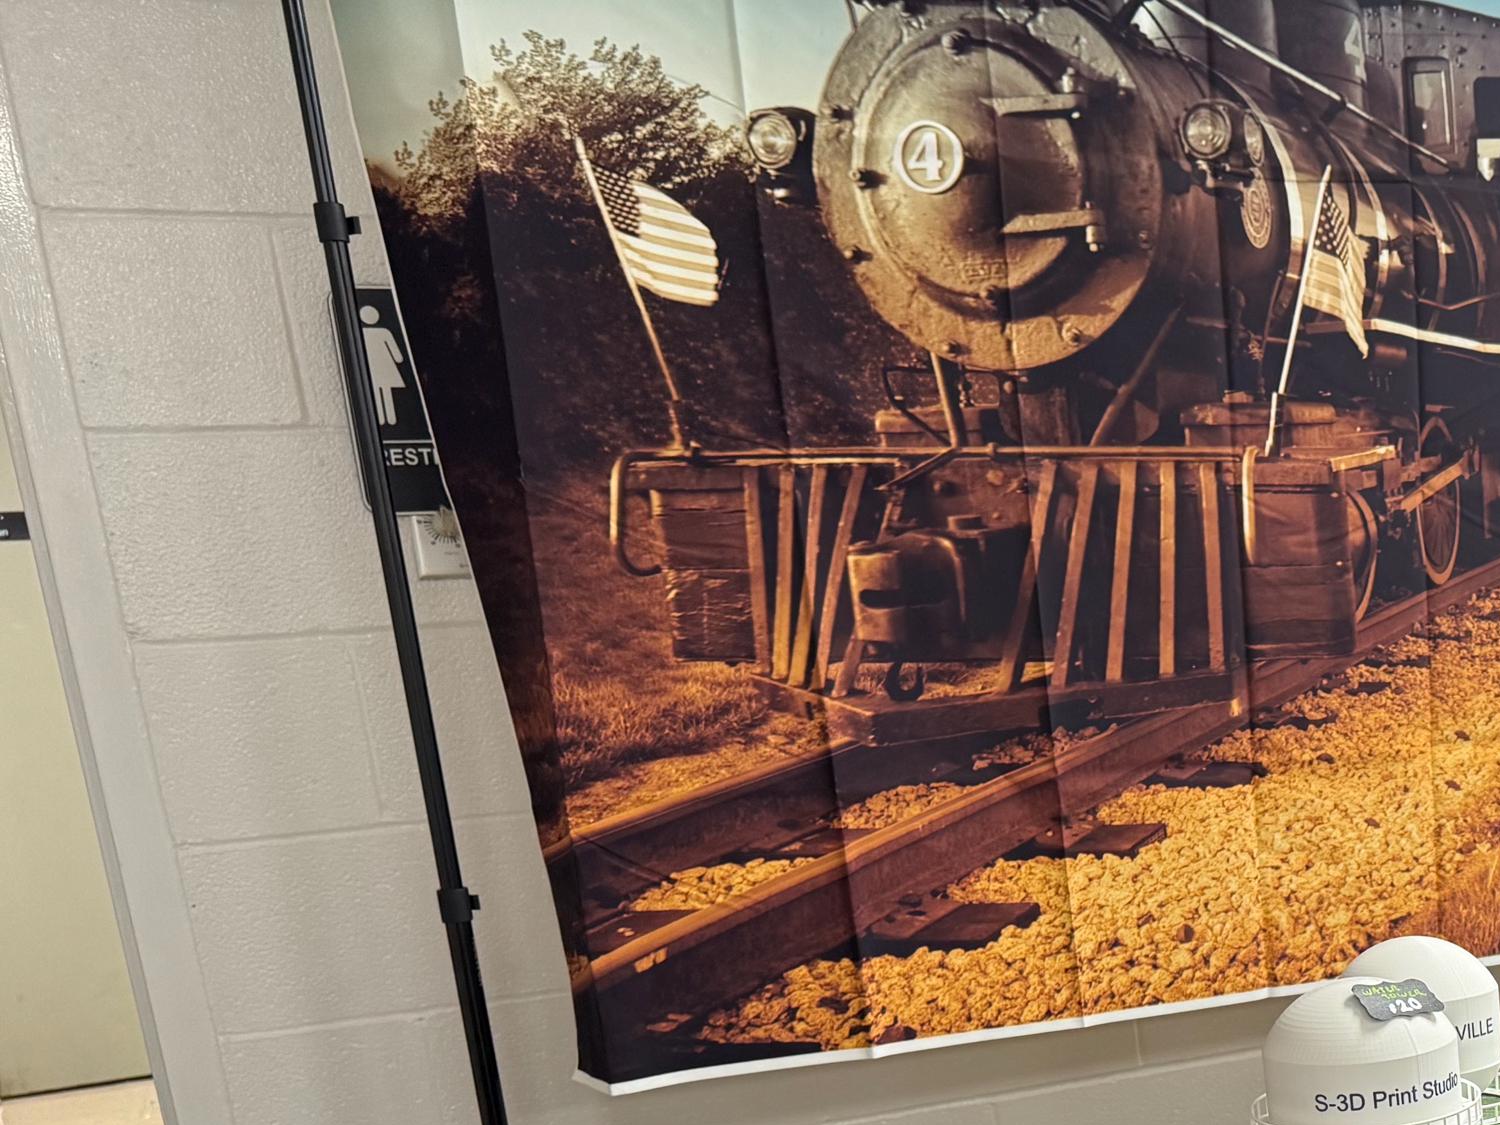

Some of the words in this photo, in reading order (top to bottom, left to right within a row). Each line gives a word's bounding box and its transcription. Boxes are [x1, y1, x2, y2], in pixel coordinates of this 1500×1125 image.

[906, 130, 945, 182] 4
[385, 447, 440, 467] EST
[1381, 988, 1427, 1000] TOWER
[1314, 1093, 1366, 1113] S-3D
[1372, 1086, 1419, 1109] Print
[1422, 1071, 1459, 1100] Studio
